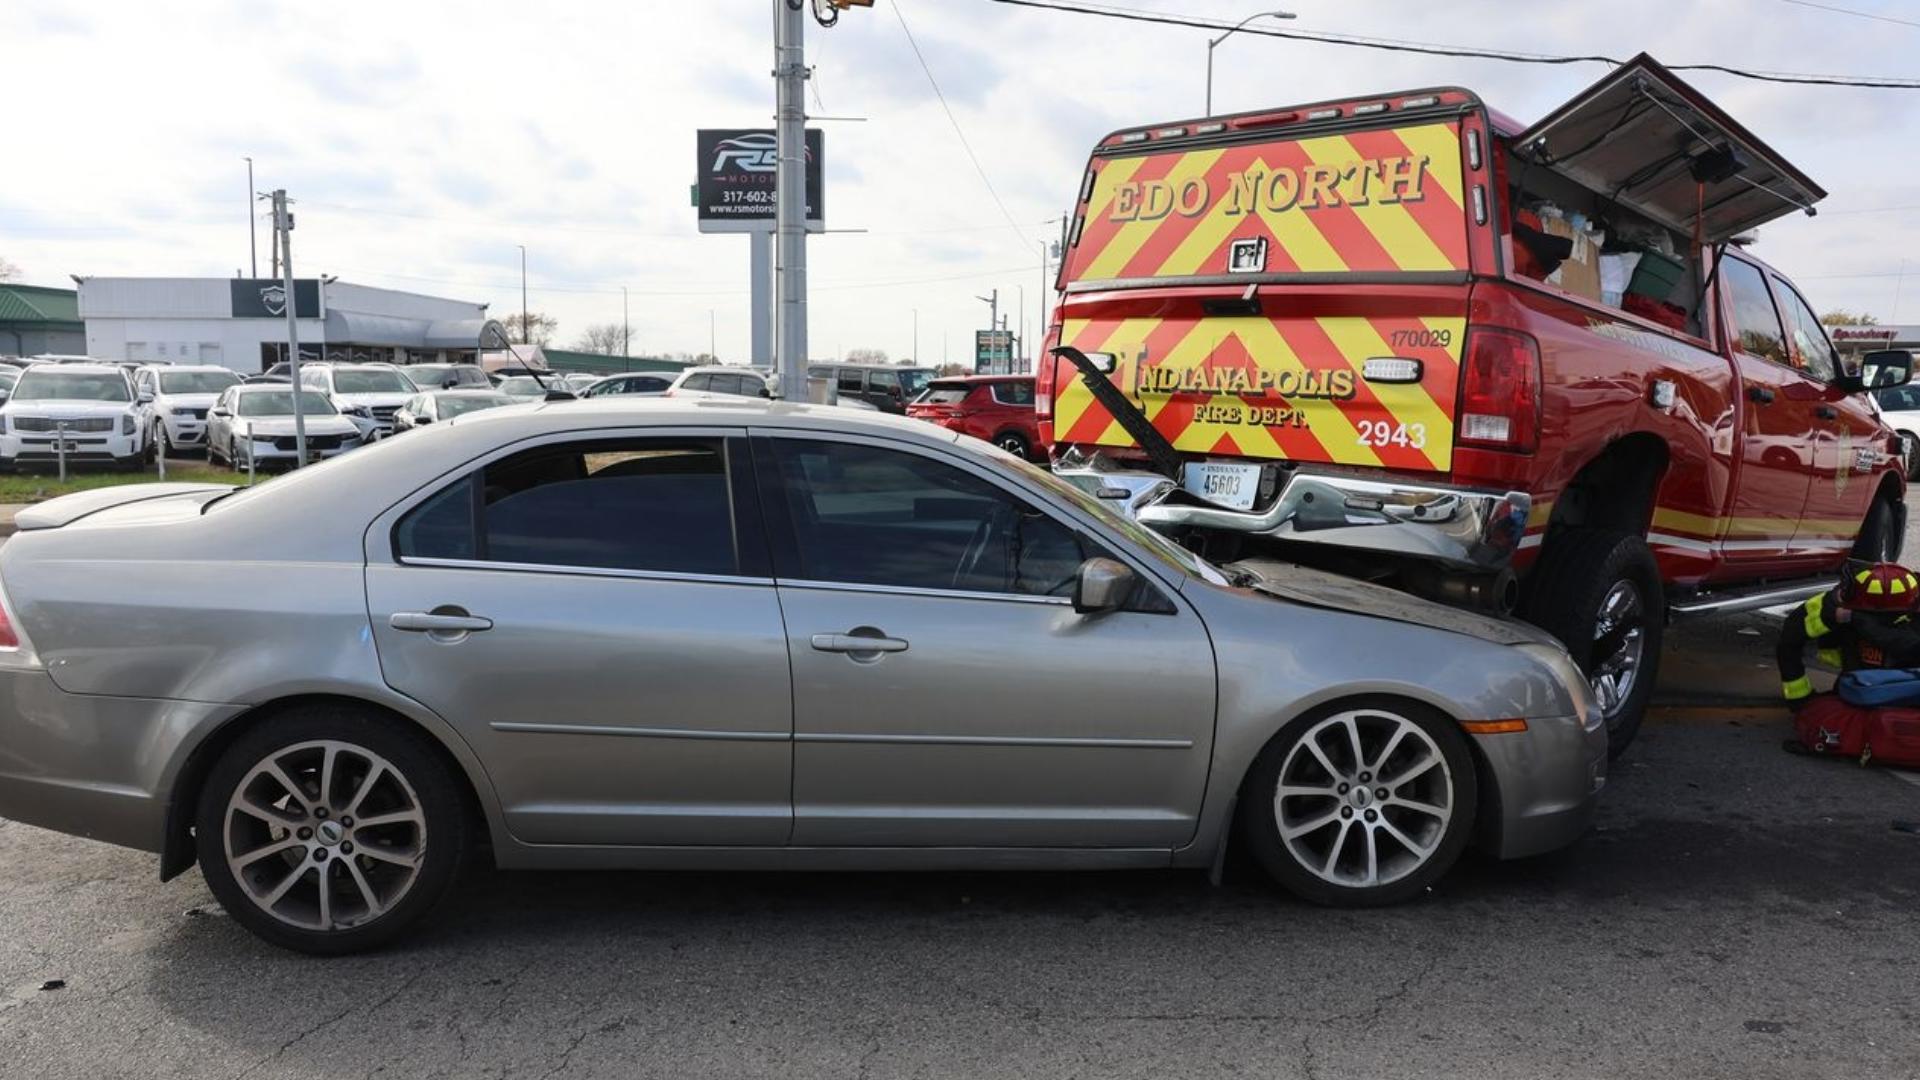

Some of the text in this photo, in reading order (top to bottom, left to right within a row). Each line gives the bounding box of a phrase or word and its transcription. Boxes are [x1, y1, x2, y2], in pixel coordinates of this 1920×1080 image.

[728, 174, 777, 183] MOTOR
[1109, 155, 1430, 222] EDO NORTH
[723, 190, 777, 203] 317-602-8
[1391, 329, 1452, 348] 170029
[1118, 343, 1356, 415] INDIANAPOLIS
[1193, 403, 1311, 429] FIRE DEPT.
[1357, 419, 1427, 449] 2943
[1207, 465, 1241, 473] INDIANA
[1204, 474, 1242, 496] 45603
